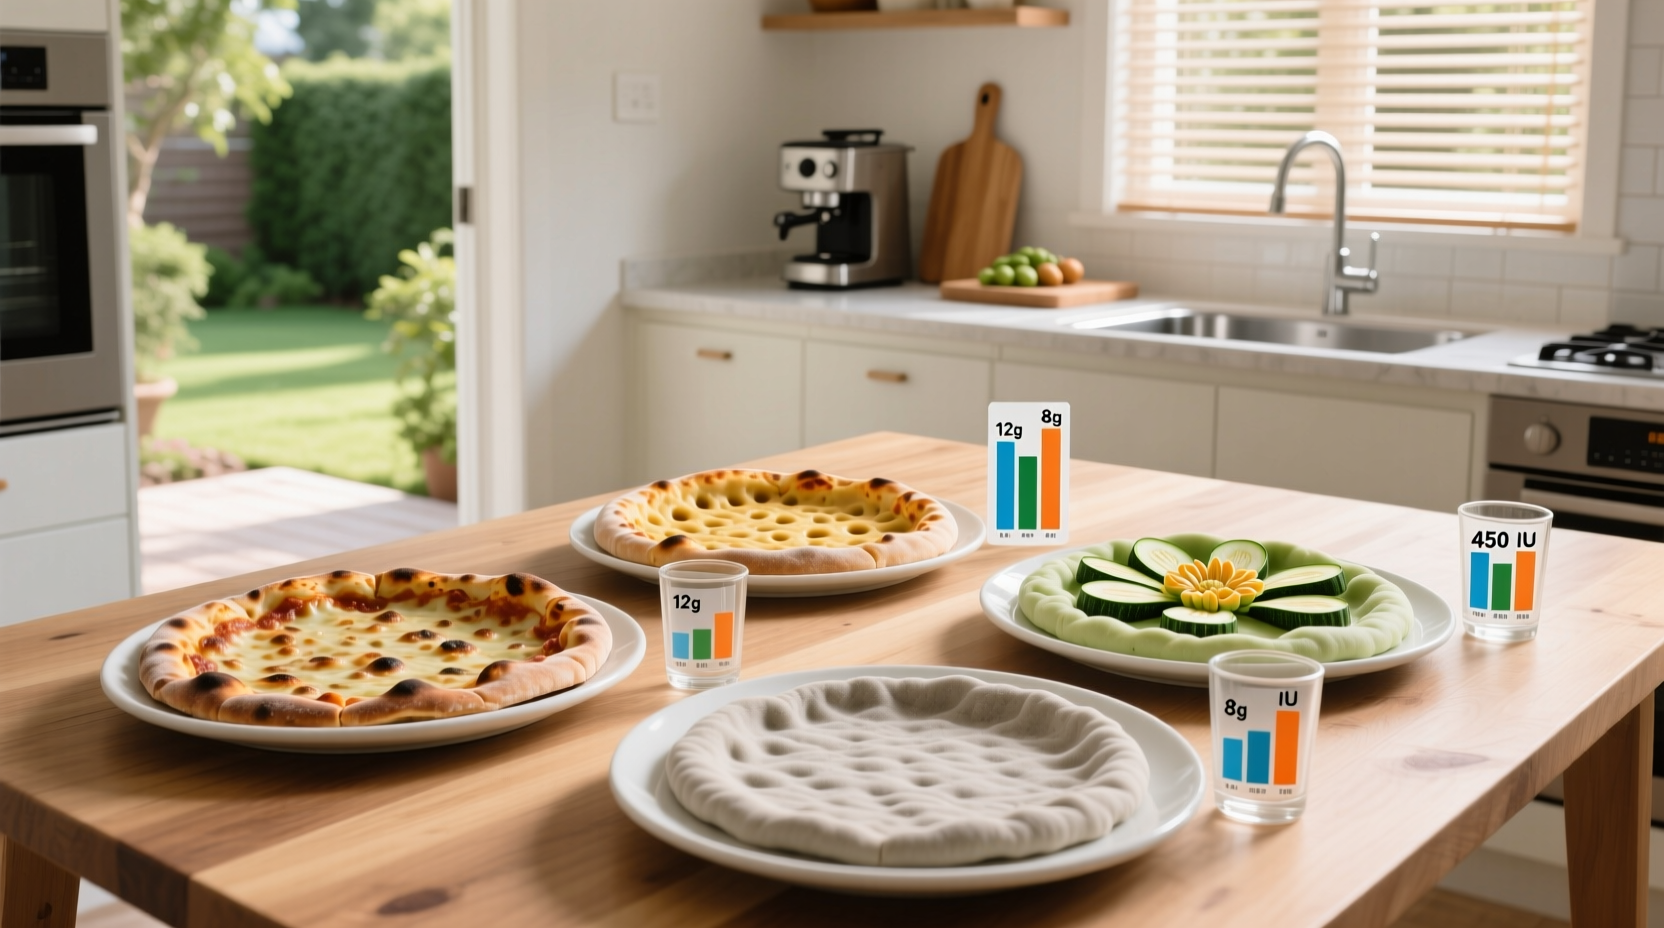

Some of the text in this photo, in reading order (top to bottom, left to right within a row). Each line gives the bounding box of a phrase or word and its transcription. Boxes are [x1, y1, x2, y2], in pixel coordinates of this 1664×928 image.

[1041, 409, 1062, 427] 8g
[996, 422, 1022, 440] 12g
[1471, 531, 1537, 548] 450 IU
[673, 594, 701, 613] 12g
[1279, 690, 1298, 706] IU
[1224, 698, 1247, 721] 8g
